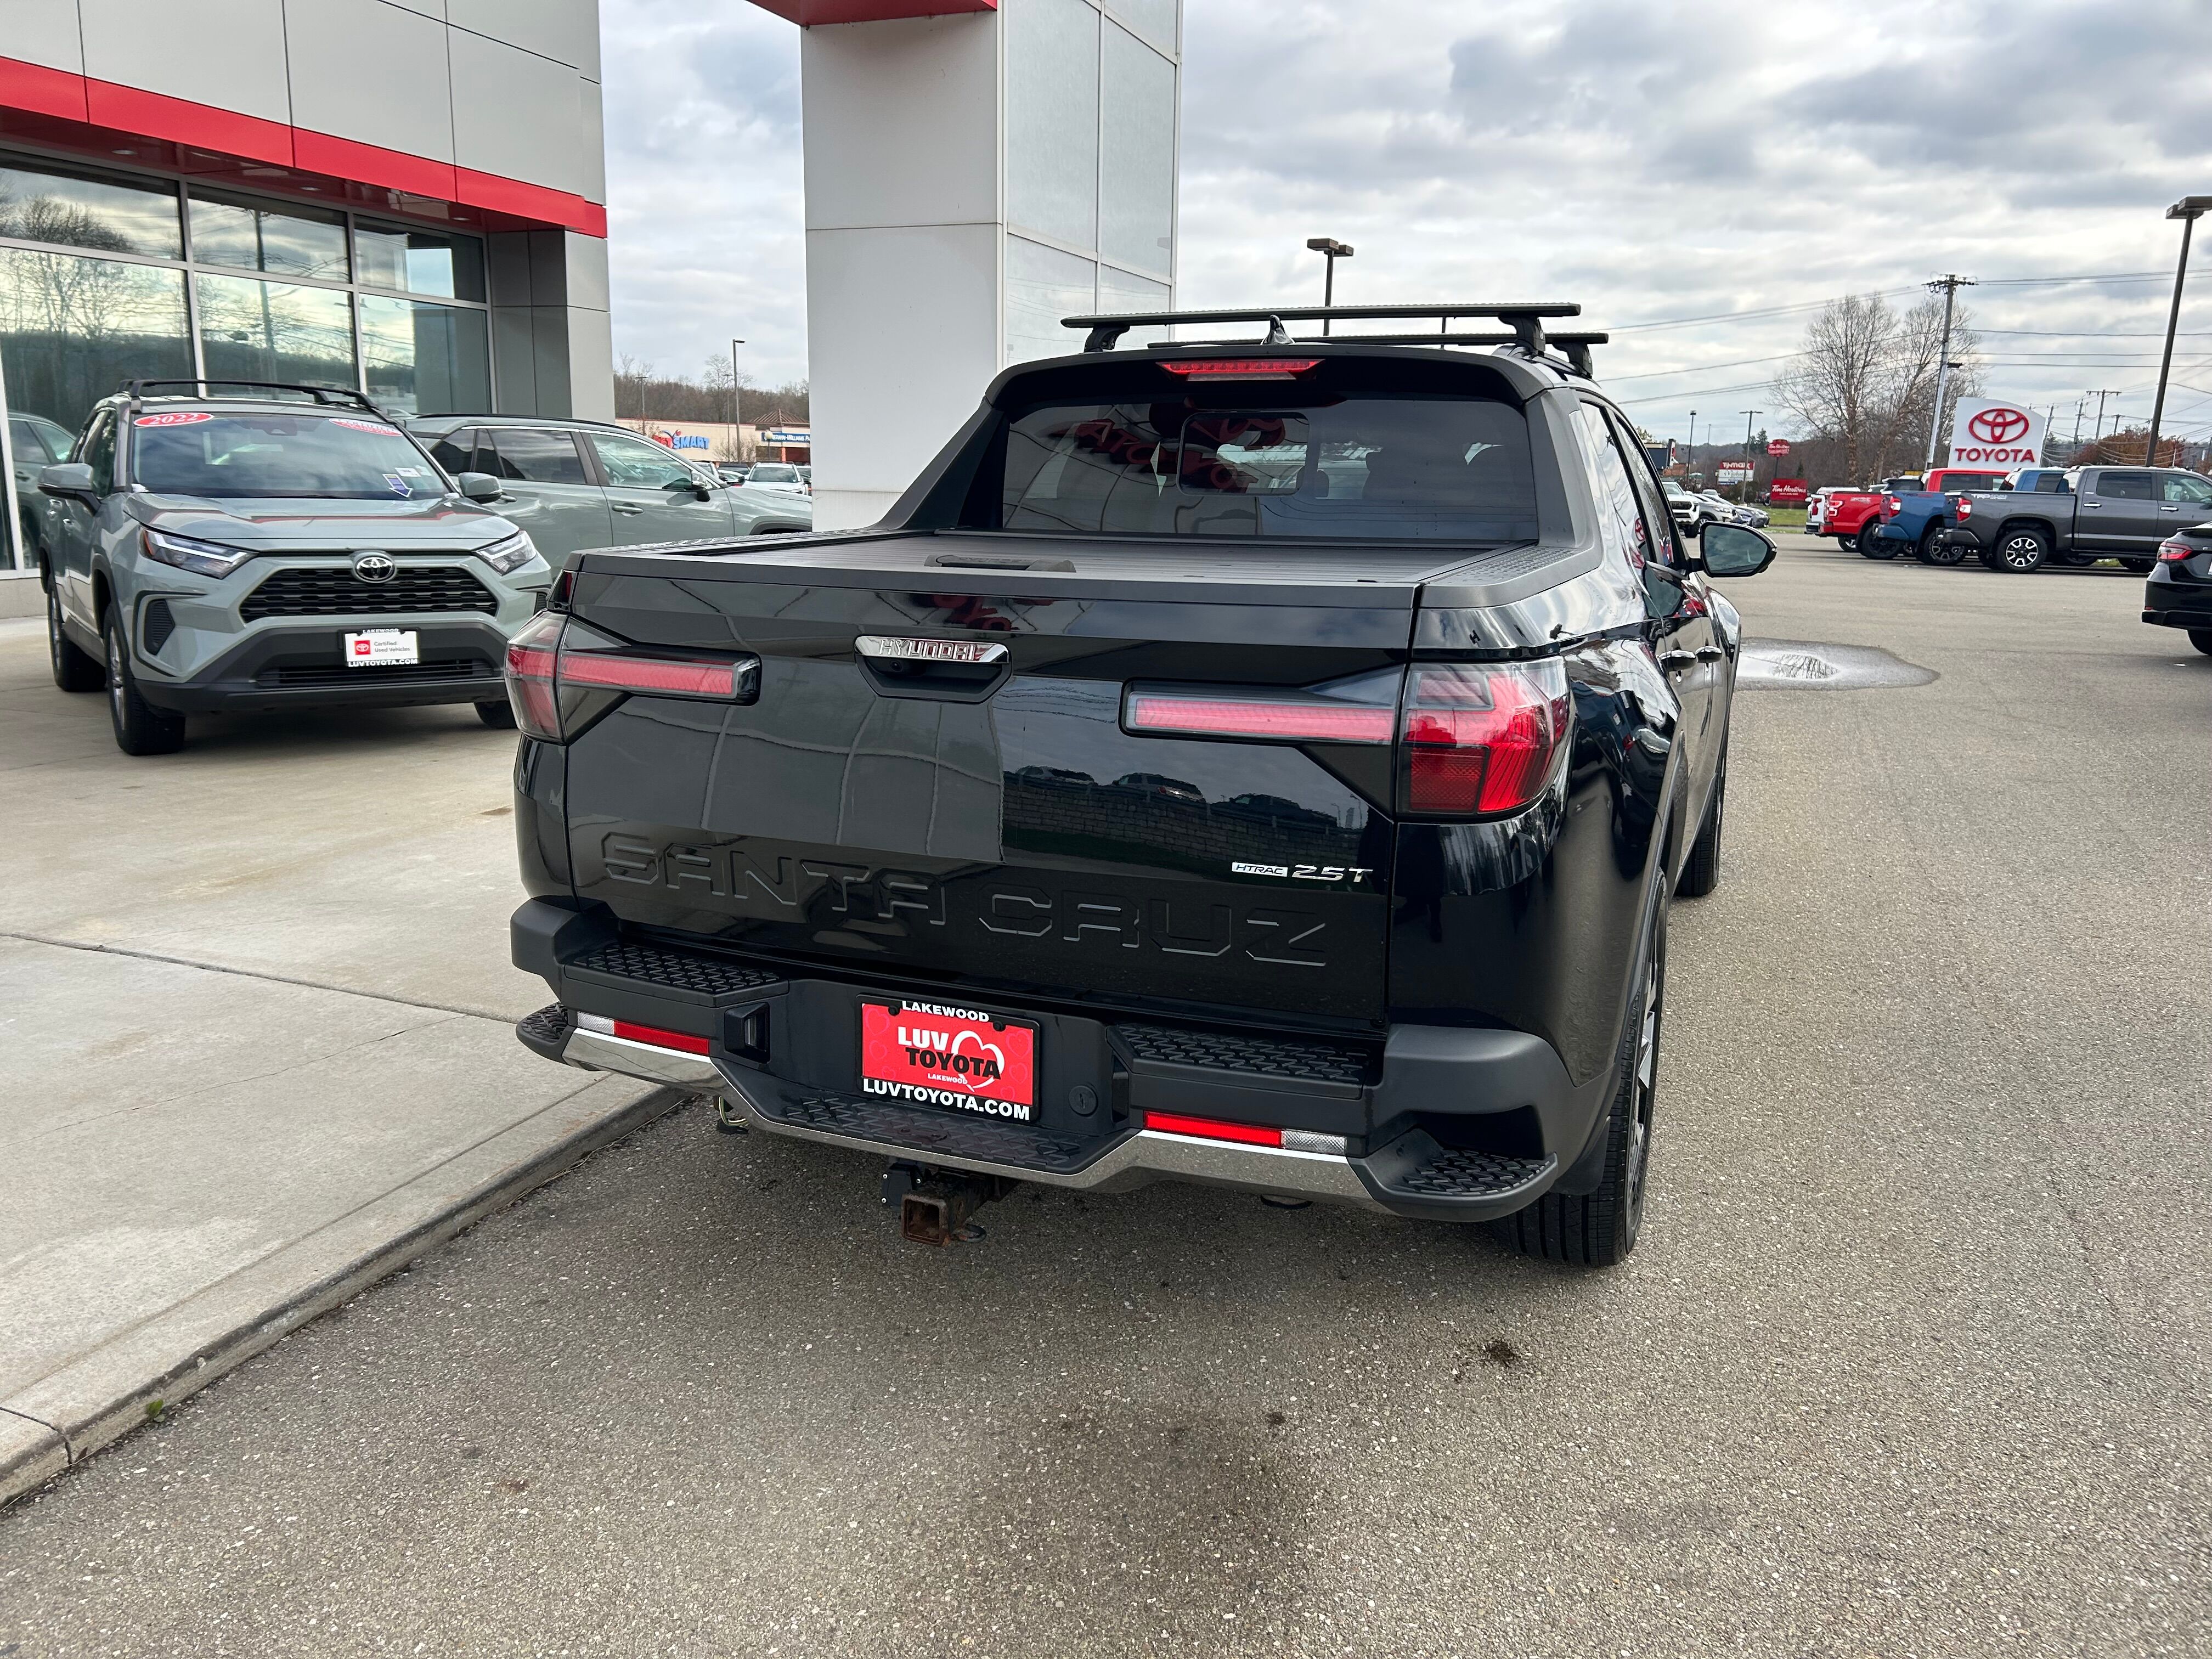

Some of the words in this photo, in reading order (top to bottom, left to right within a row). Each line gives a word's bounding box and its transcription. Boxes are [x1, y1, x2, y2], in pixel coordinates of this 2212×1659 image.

[149, 414, 199, 425] 2022
[1955, 448, 2035, 462] TOYOTA
[1783, 484, 1806, 493] Hortons
[879, 639, 977, 661] HYUNDAI
[348, 658, 418, 667] LUVTOYOTA.COM
[1235, 864, 1284, 876] HTRAC
[601, 831, 946, 926] SANTA
[978, 881, 1326, 967] CRUZ
[901, 1000, 989, 1022] LAKEWOOD
[898, 1026, 950, 1051] LUV
[905, 1047, 1001, 1080] TOYOTA
[927, 1073, 968, 1085] LAKEWOOD
[863, 1078, 1030, 1121] LUVTOYOTA.COM
